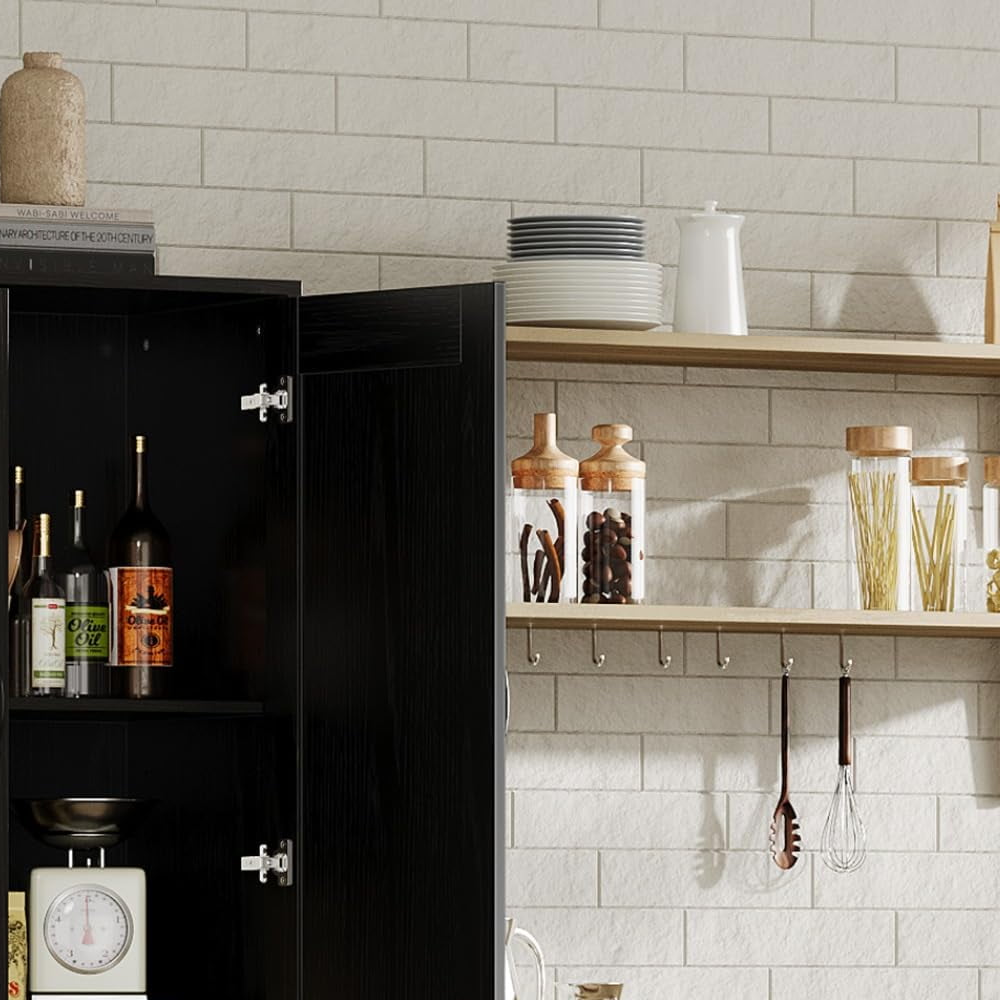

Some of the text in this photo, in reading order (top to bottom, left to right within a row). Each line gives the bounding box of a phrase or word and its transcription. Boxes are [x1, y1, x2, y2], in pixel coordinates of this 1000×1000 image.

[17, 208, 120, 220] WABI-SABI WELCOME
[18, 229, 70, 241] ARCHITECTURE
[70, 231, 80, 241] OF
[81, 231, 96, 242] THE
[96, 231, 117, 243] 20TH
[118, 232, 154, 244] CENTURY
[68, 618, 107, 633] Olive
[75, 632, 102, 646] Oil
